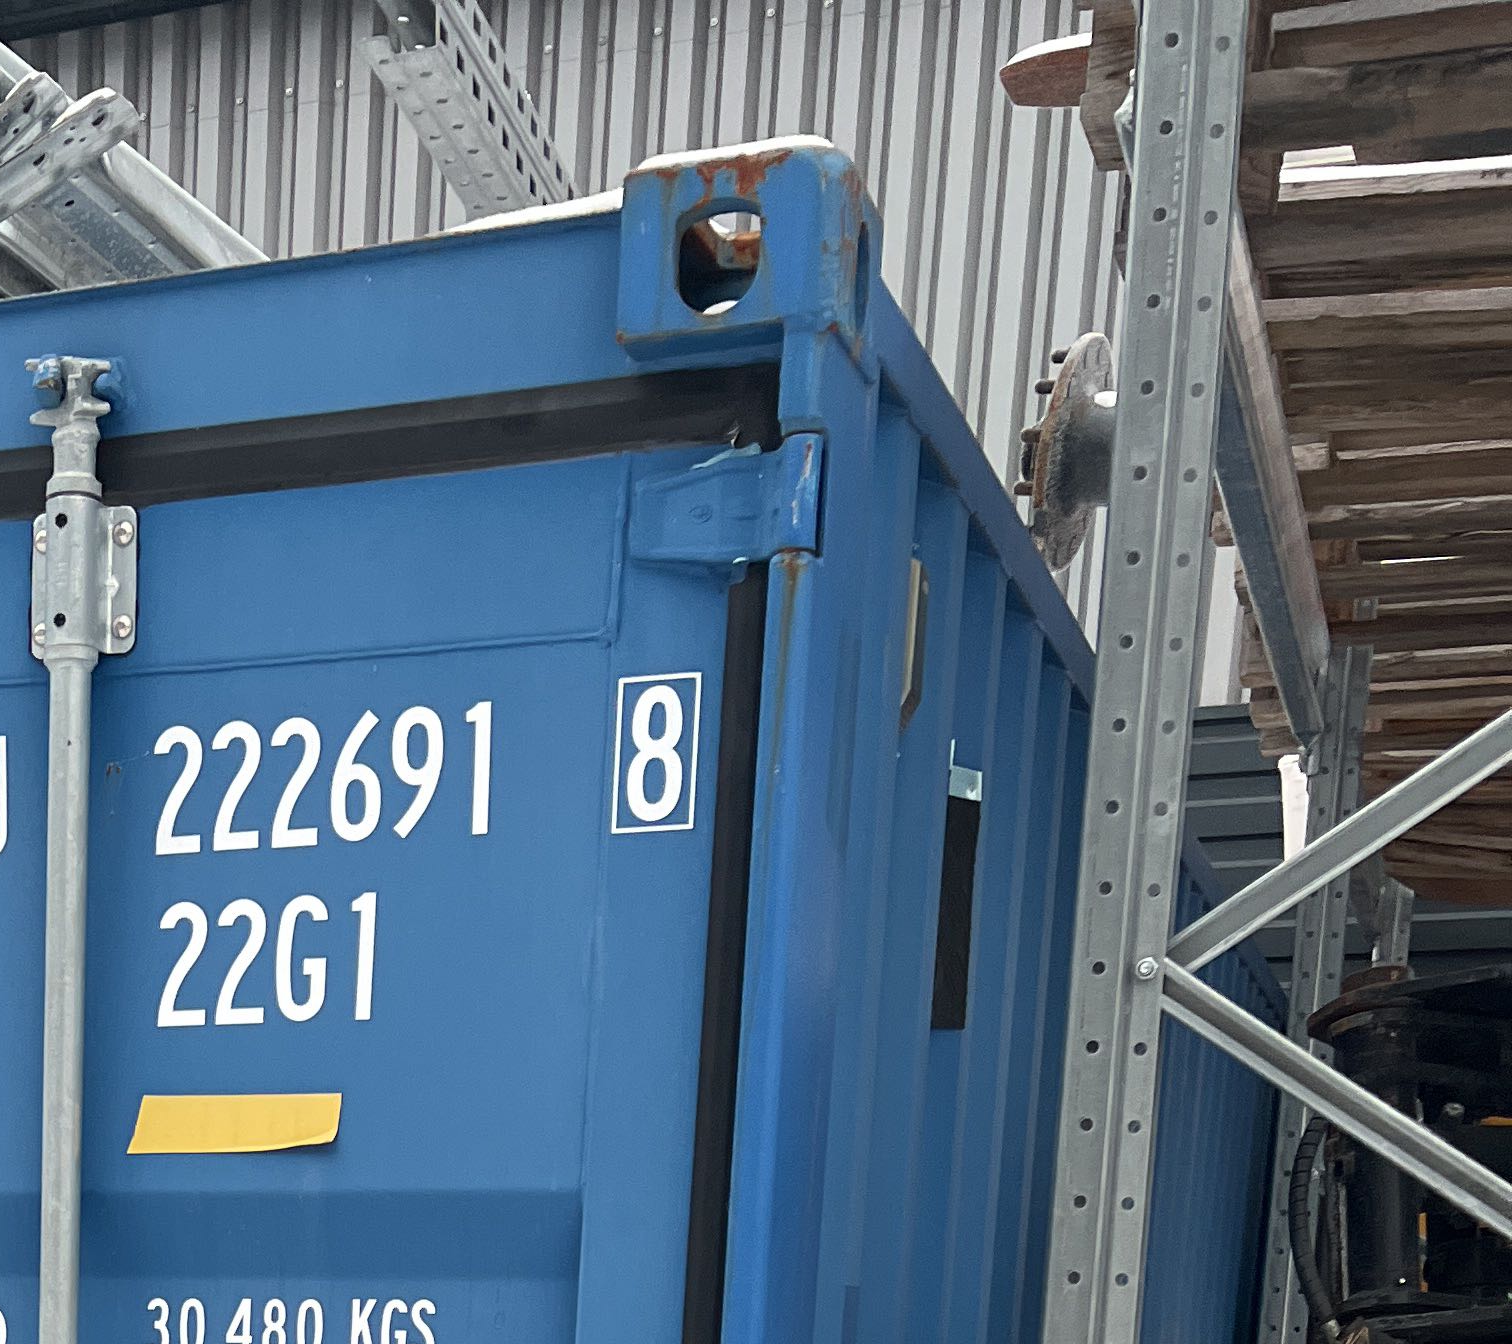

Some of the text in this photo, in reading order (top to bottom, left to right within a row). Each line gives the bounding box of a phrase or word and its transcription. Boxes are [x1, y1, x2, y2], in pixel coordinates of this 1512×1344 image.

[154, 701, 492, 855] 222691
[626, 684, 683, 822] 8
[156, 892, 378, 1028] 22G1
